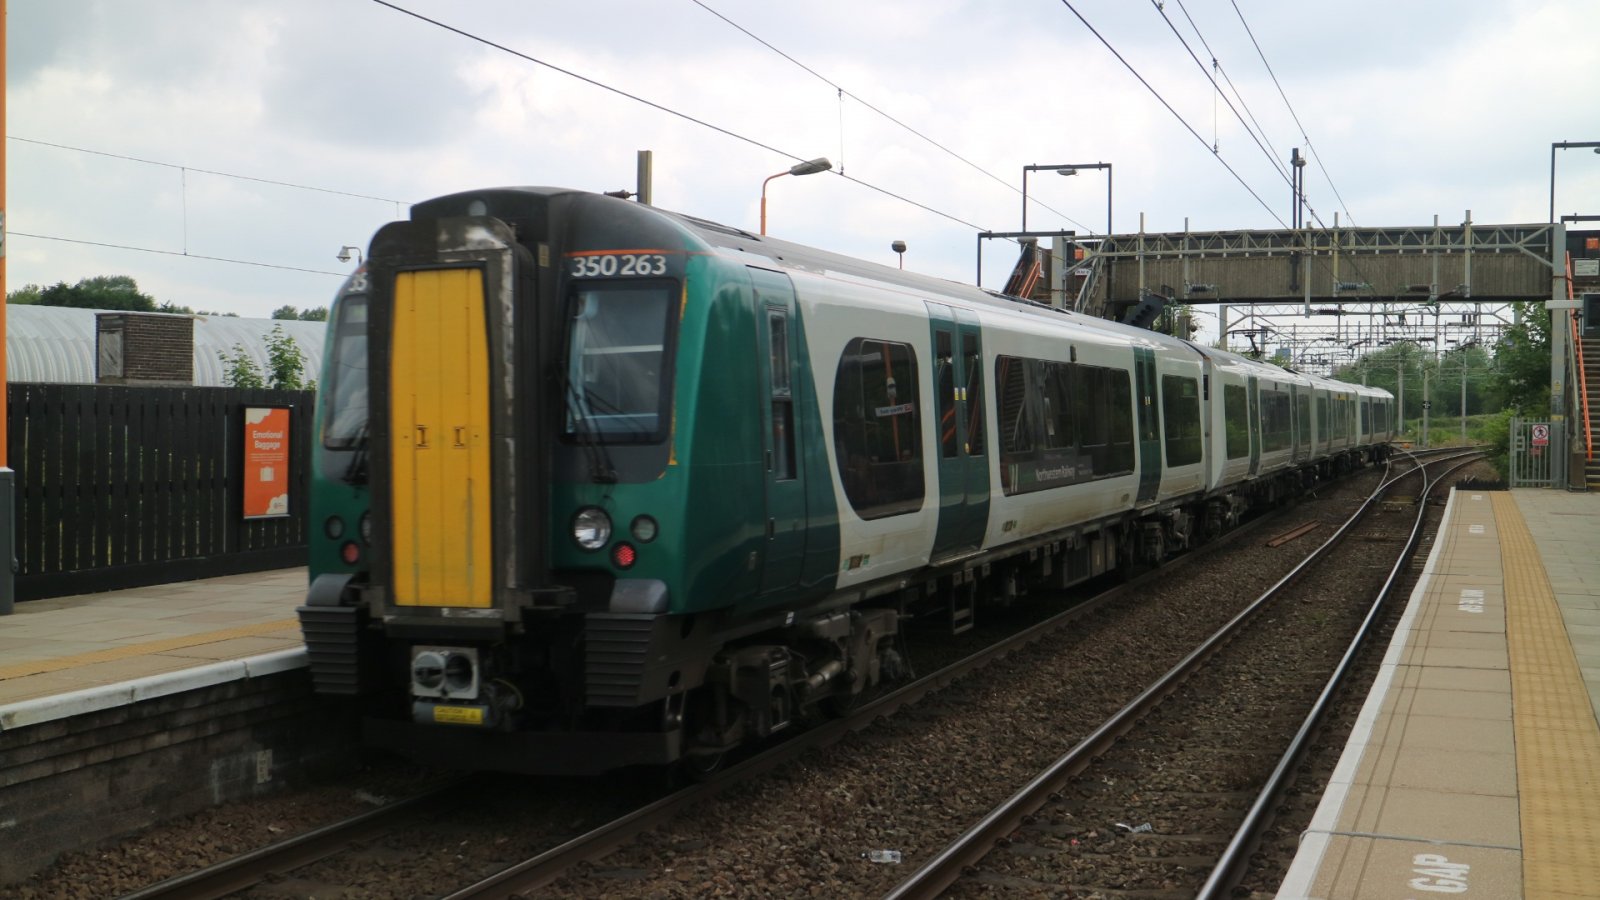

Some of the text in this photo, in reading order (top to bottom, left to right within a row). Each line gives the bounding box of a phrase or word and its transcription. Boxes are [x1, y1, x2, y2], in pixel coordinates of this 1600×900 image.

[572, 254, 667, 277] 350 263
[253, 430, 283, 439] Emotional
[255, 441, 280, 450] Baggage
[1407, 853, 1470, 893] GAP
